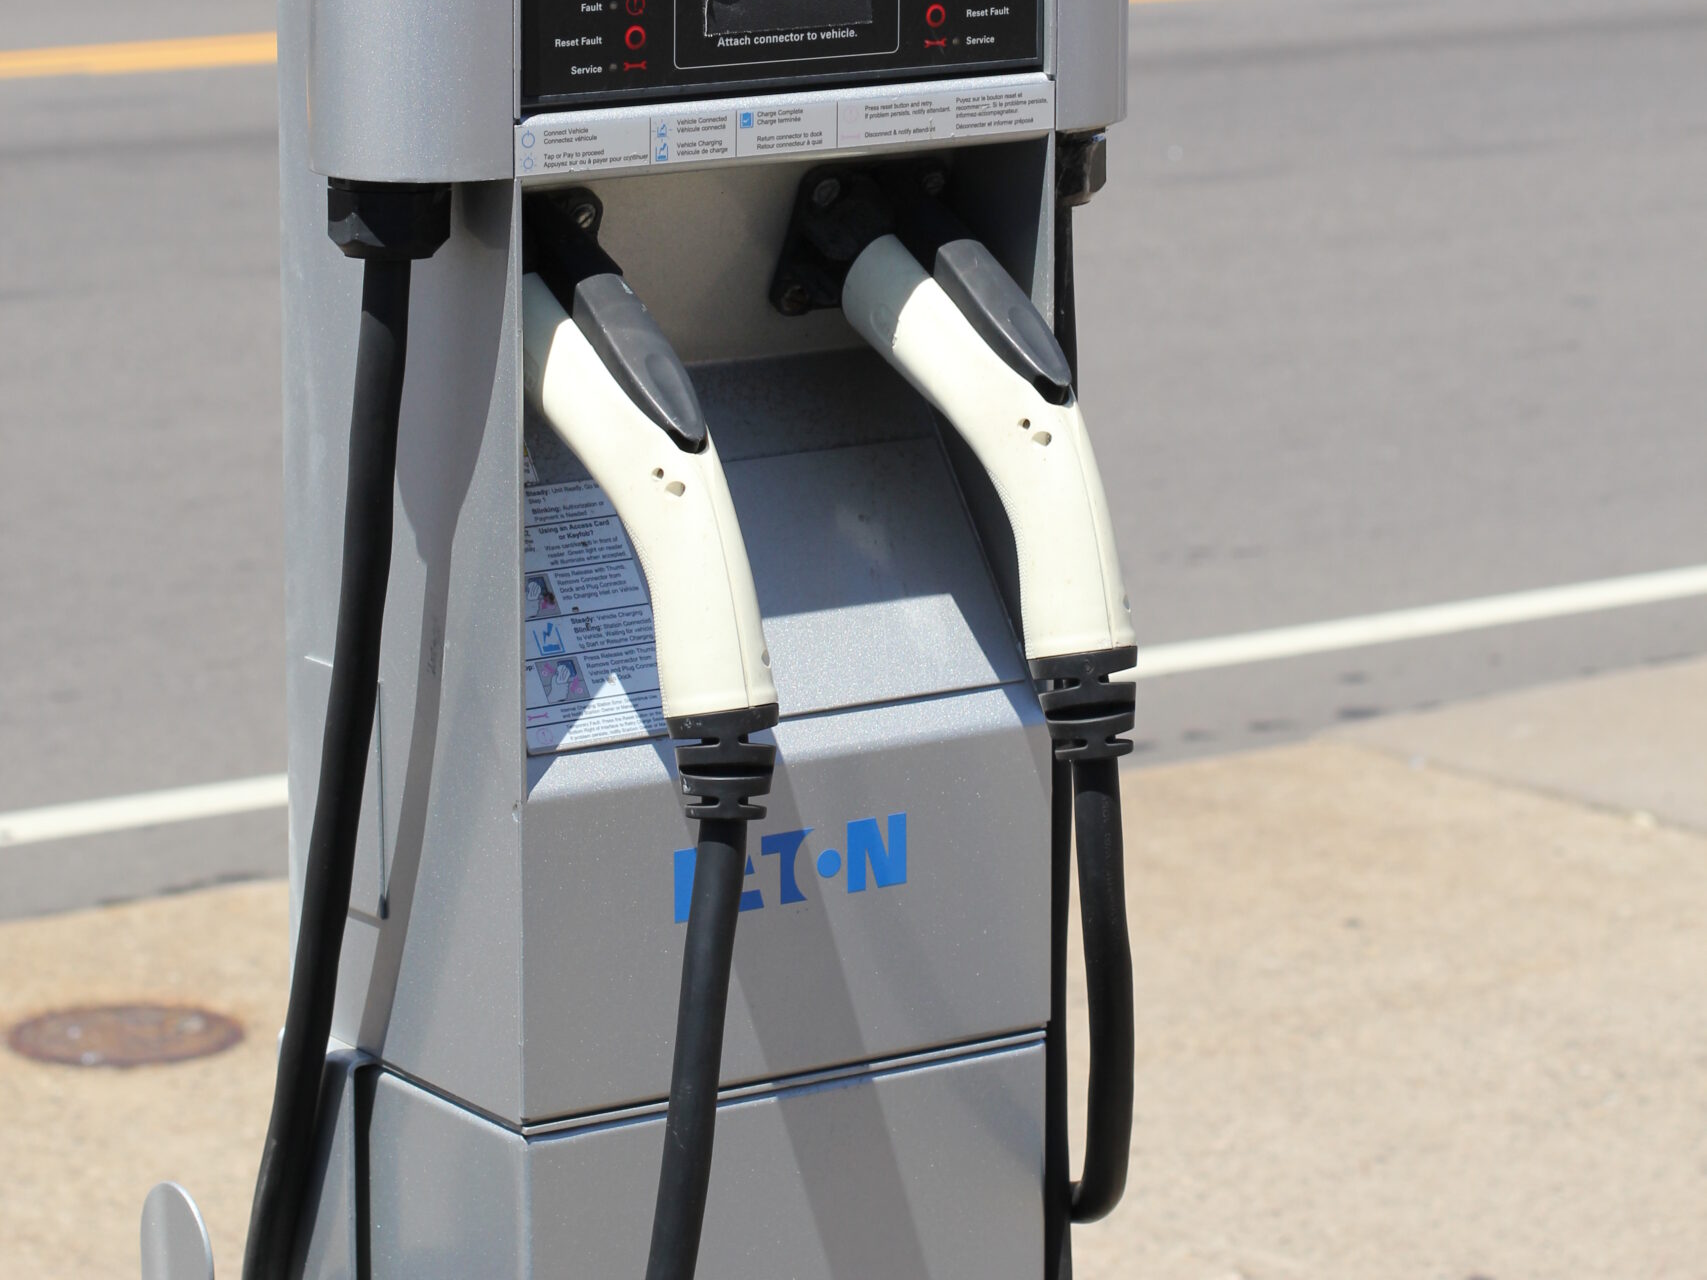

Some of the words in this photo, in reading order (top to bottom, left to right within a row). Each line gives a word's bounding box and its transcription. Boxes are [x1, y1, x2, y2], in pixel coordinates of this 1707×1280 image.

[581, 2, 603, 13] Fault
[966, 8, 988, 18] Reset
[990, 6, 1010, 16] Fault
[554, 37, 580, 48] Reset
[581, 36, 603, 47] Fault
[717, 35, 750, 48] Attach
[753, 32, 804, 45] connector
[807, 30, 817, 41] to
[820, 27, 858, 40] vehicle.
[966, 36, 995, 45] Service
[571, 64, 603, 75] Service
[869, 112, 890, 120] problem
[544, 137, 573, 145] Connectez
[544, 153, 554, 161] Tap
[563, 152, 574, 160] Pay
[582, 149, 604, 158] proceed
[538, 526, 558, 534] Using
[569, 522, 592, 530] Access
[574, 624, 602, 634] Blining:
